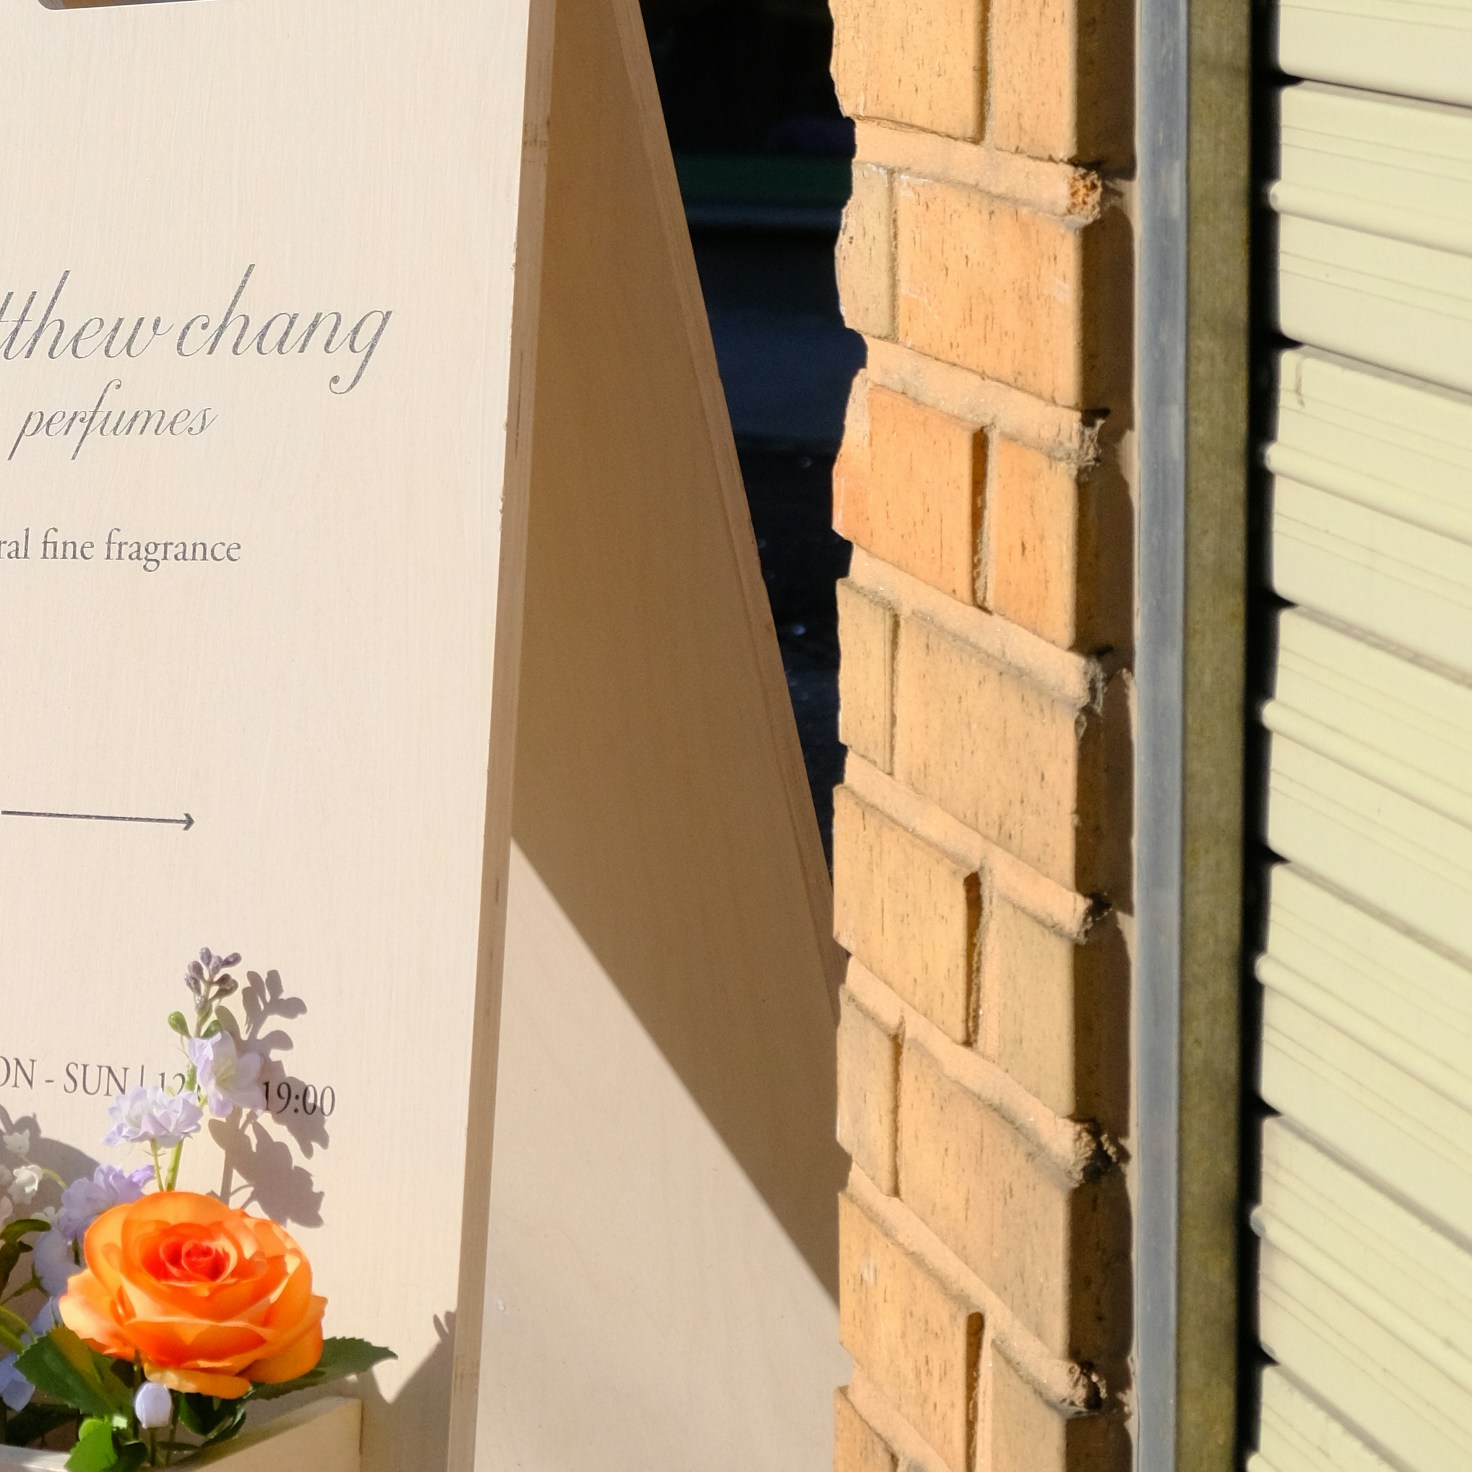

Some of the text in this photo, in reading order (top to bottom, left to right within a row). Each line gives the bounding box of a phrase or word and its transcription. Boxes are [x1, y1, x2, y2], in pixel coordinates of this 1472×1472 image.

[177, 263, 393, 396] chang
[6, 378, 220, 462] perfumes
[39, 526, 95, 562] fine
[103, 527, 242, 573] fragrance
[63, 1061, 130, 1098] SUN
[261, 1079, 336, 1118] 19:00
